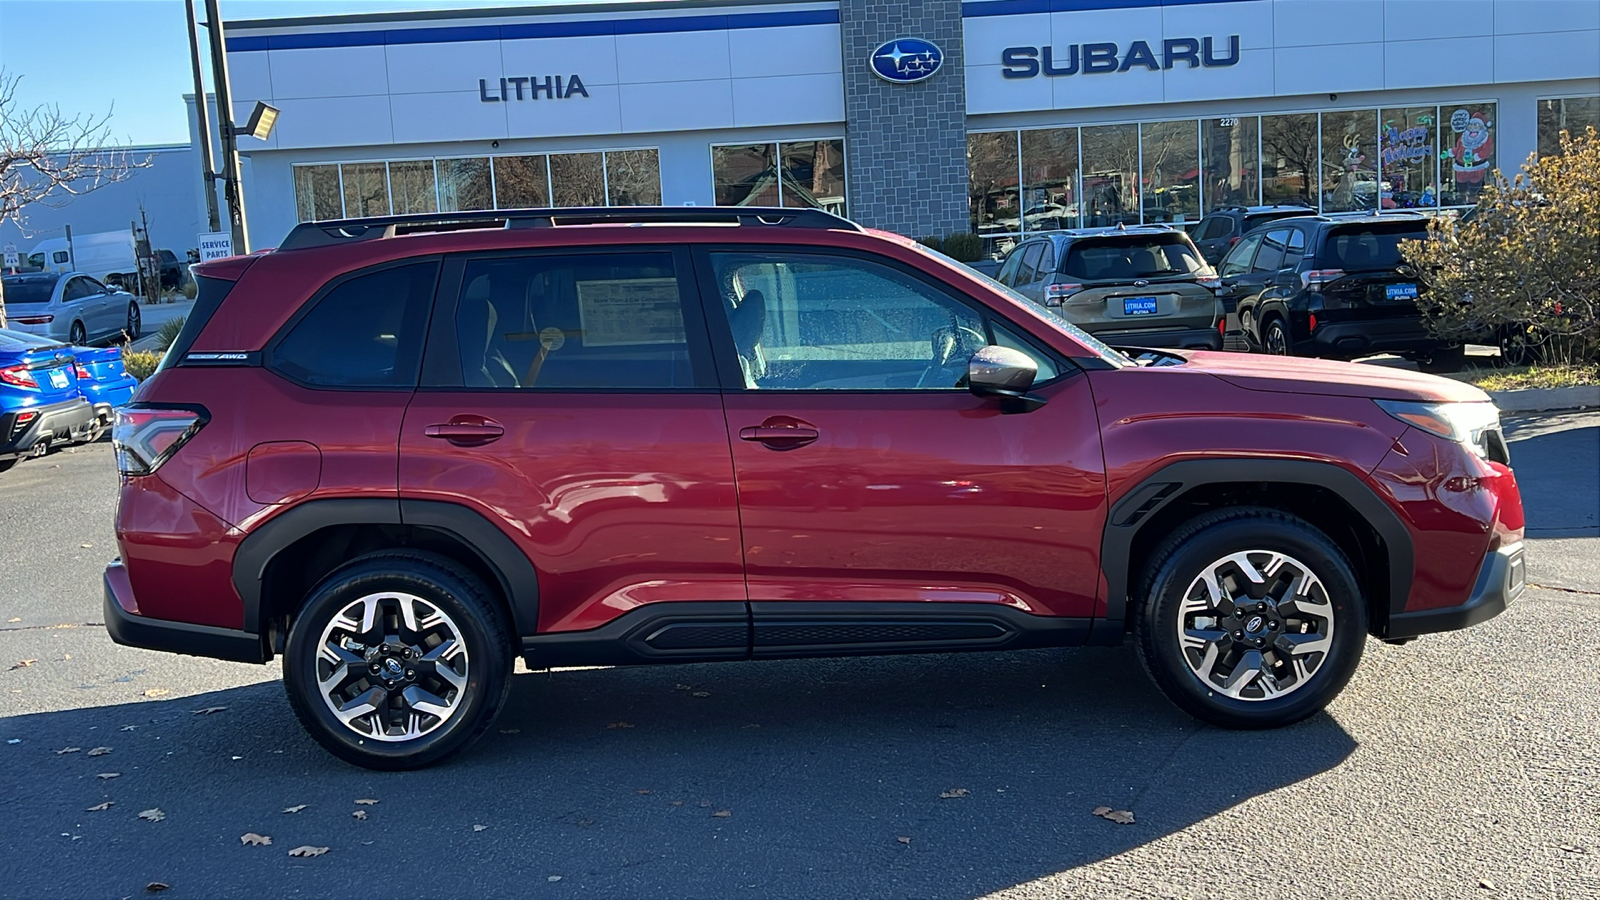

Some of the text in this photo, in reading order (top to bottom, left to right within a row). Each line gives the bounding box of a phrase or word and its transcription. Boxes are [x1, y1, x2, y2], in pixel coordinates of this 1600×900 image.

[1002, 35, 1240, 79] SUBARU
[479, 74, 589, 102] LITHIA
[1220, 117, 1239, 127] 2270
[1386, 126, 1428, 145] Happy
[202, 240, 230, 249] SERVICE
[206, 250, 228, 258] PARTS
[1386, 288, 1417, 296] LITHIA.COM
[1125, 302, 1156, 310] LITHIA.COM
